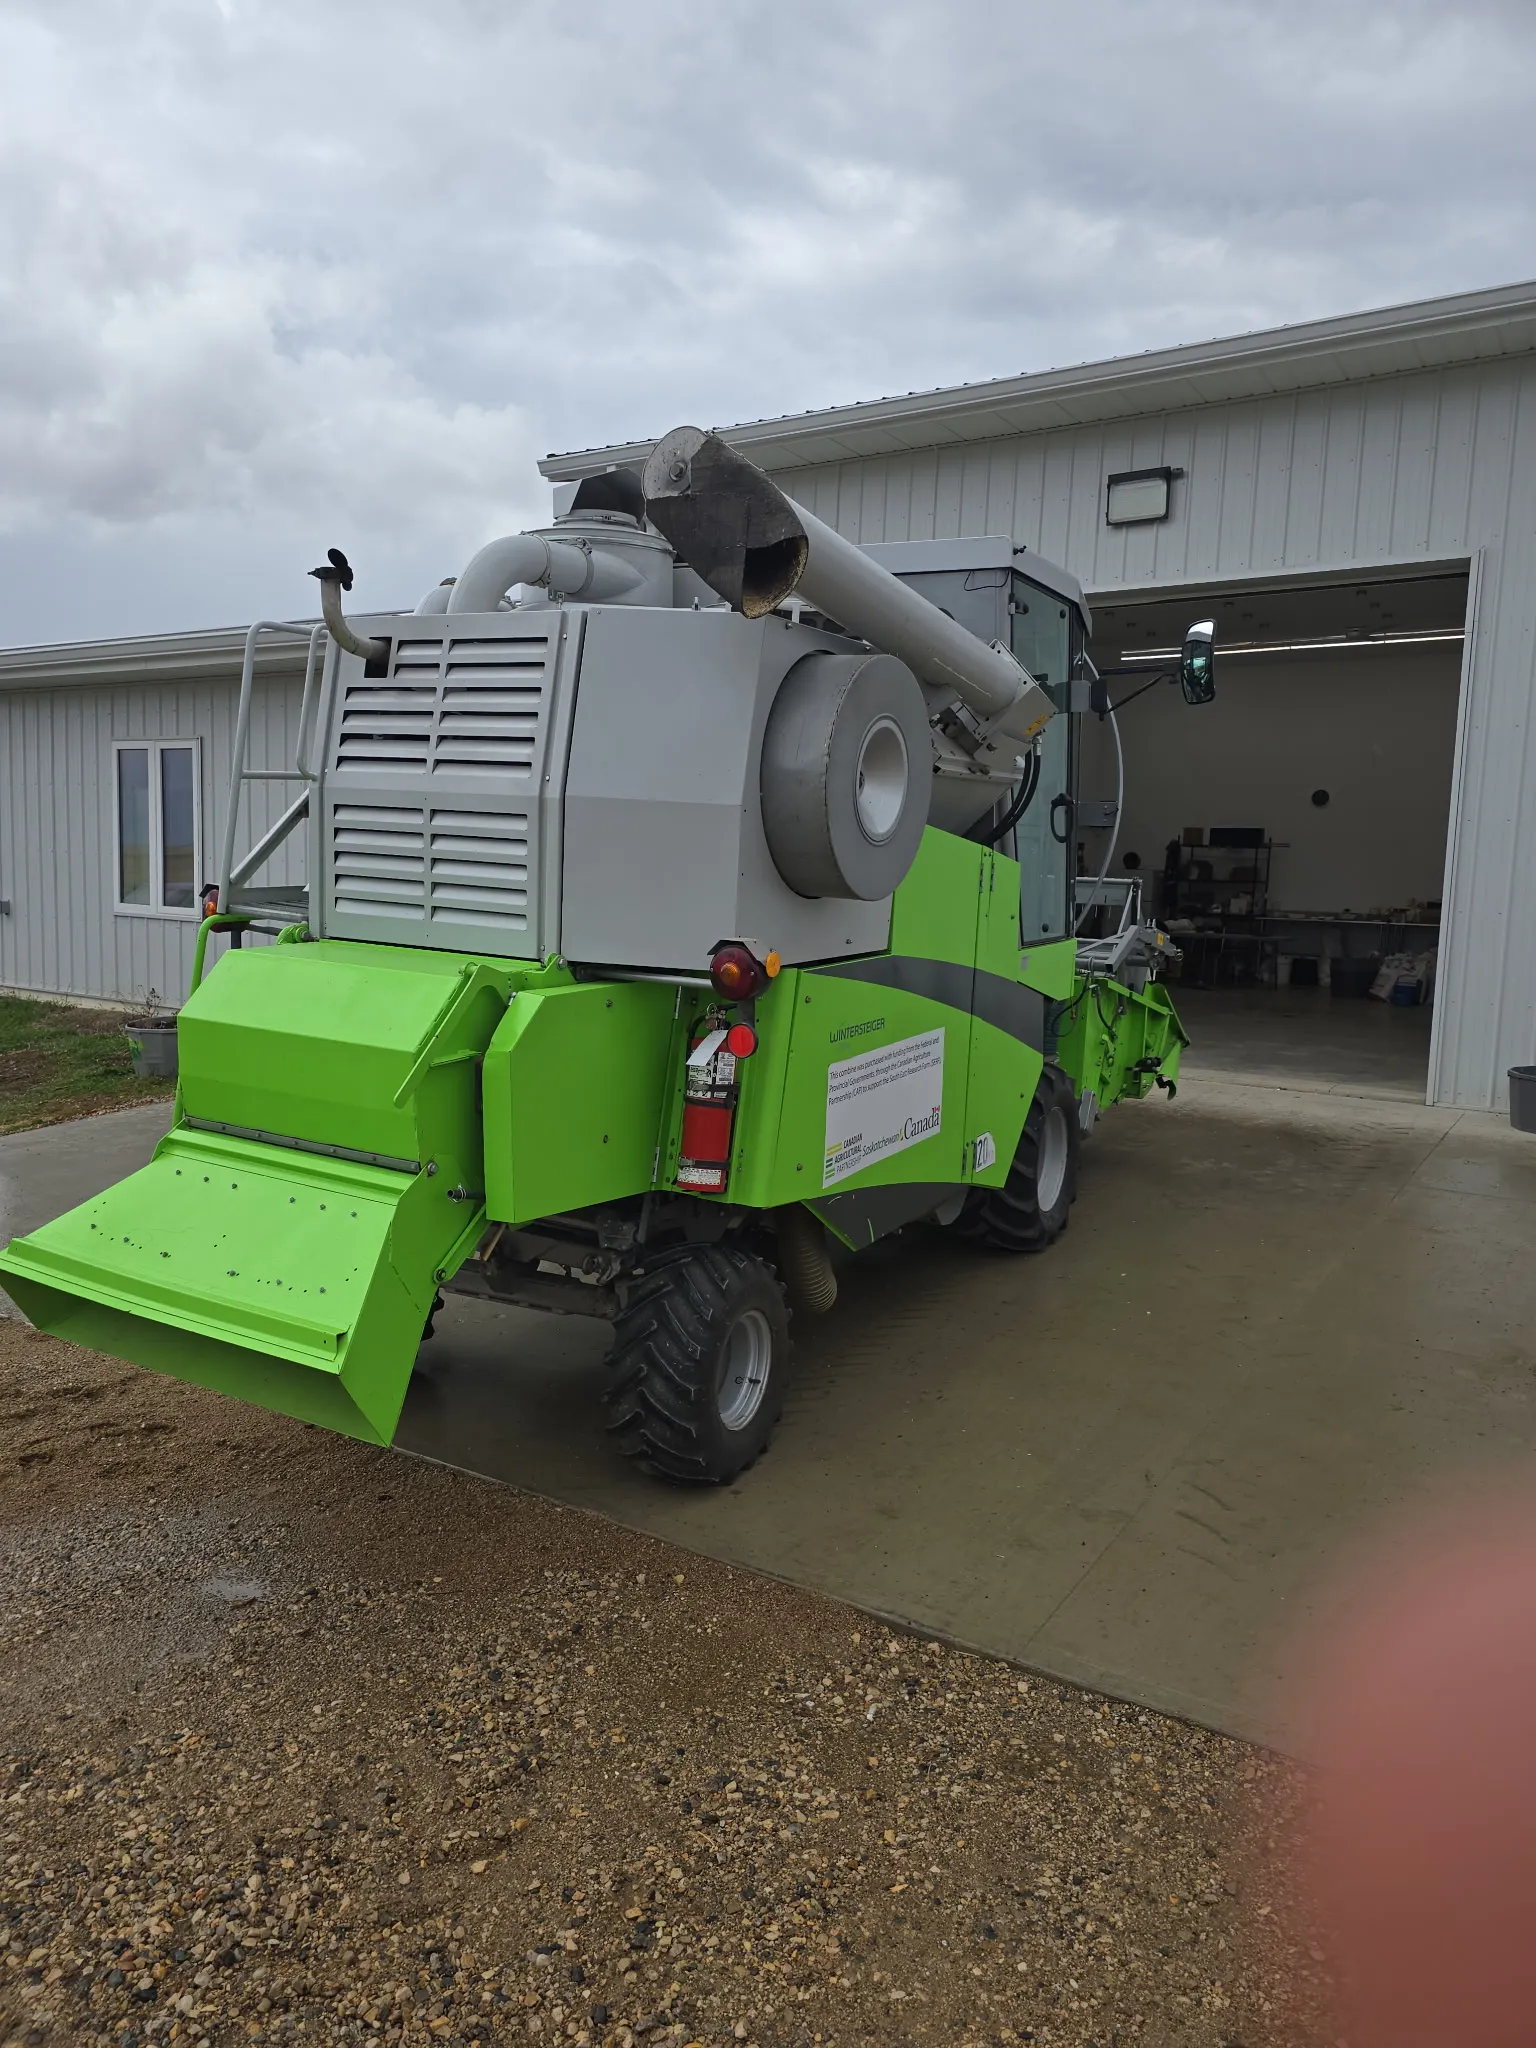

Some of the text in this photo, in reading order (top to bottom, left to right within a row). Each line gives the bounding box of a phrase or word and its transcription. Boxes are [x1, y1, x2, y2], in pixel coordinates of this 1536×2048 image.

[829, 1017, 885, 1043] WINTERSTEIGER
[829, 1079, 848, 1093] Provincial
[875, 1064, 890, 1076] through
[897, 1057, 912, 1068] Canadian
[913, 1051, 930, 1063] Agriculture
[830, 1071, 838, 1080] This
[839, 1065, 856, 1077] combine
[865, 1056, 884, 1069] purchased
[893, 1048, 905, 1057] funding
[906, 1045, 914, 1053] from
[829, 1089, 851, 1106] Partnership
[868, 1078, 882, 1091] support
[890, 1072, 899, 1082] South
[908, 1063, 921, 1075] Research
[904, 1107, 939, 1140] Canada
[834, 1144, 862, 1164] AGRICULTURAL
[843, 1133, 863, 1149] CANADIAN
[862, 1133, 899, 1157] Saskatchewan
[836, 1154, 862, 1173] PARTNERSHIP
